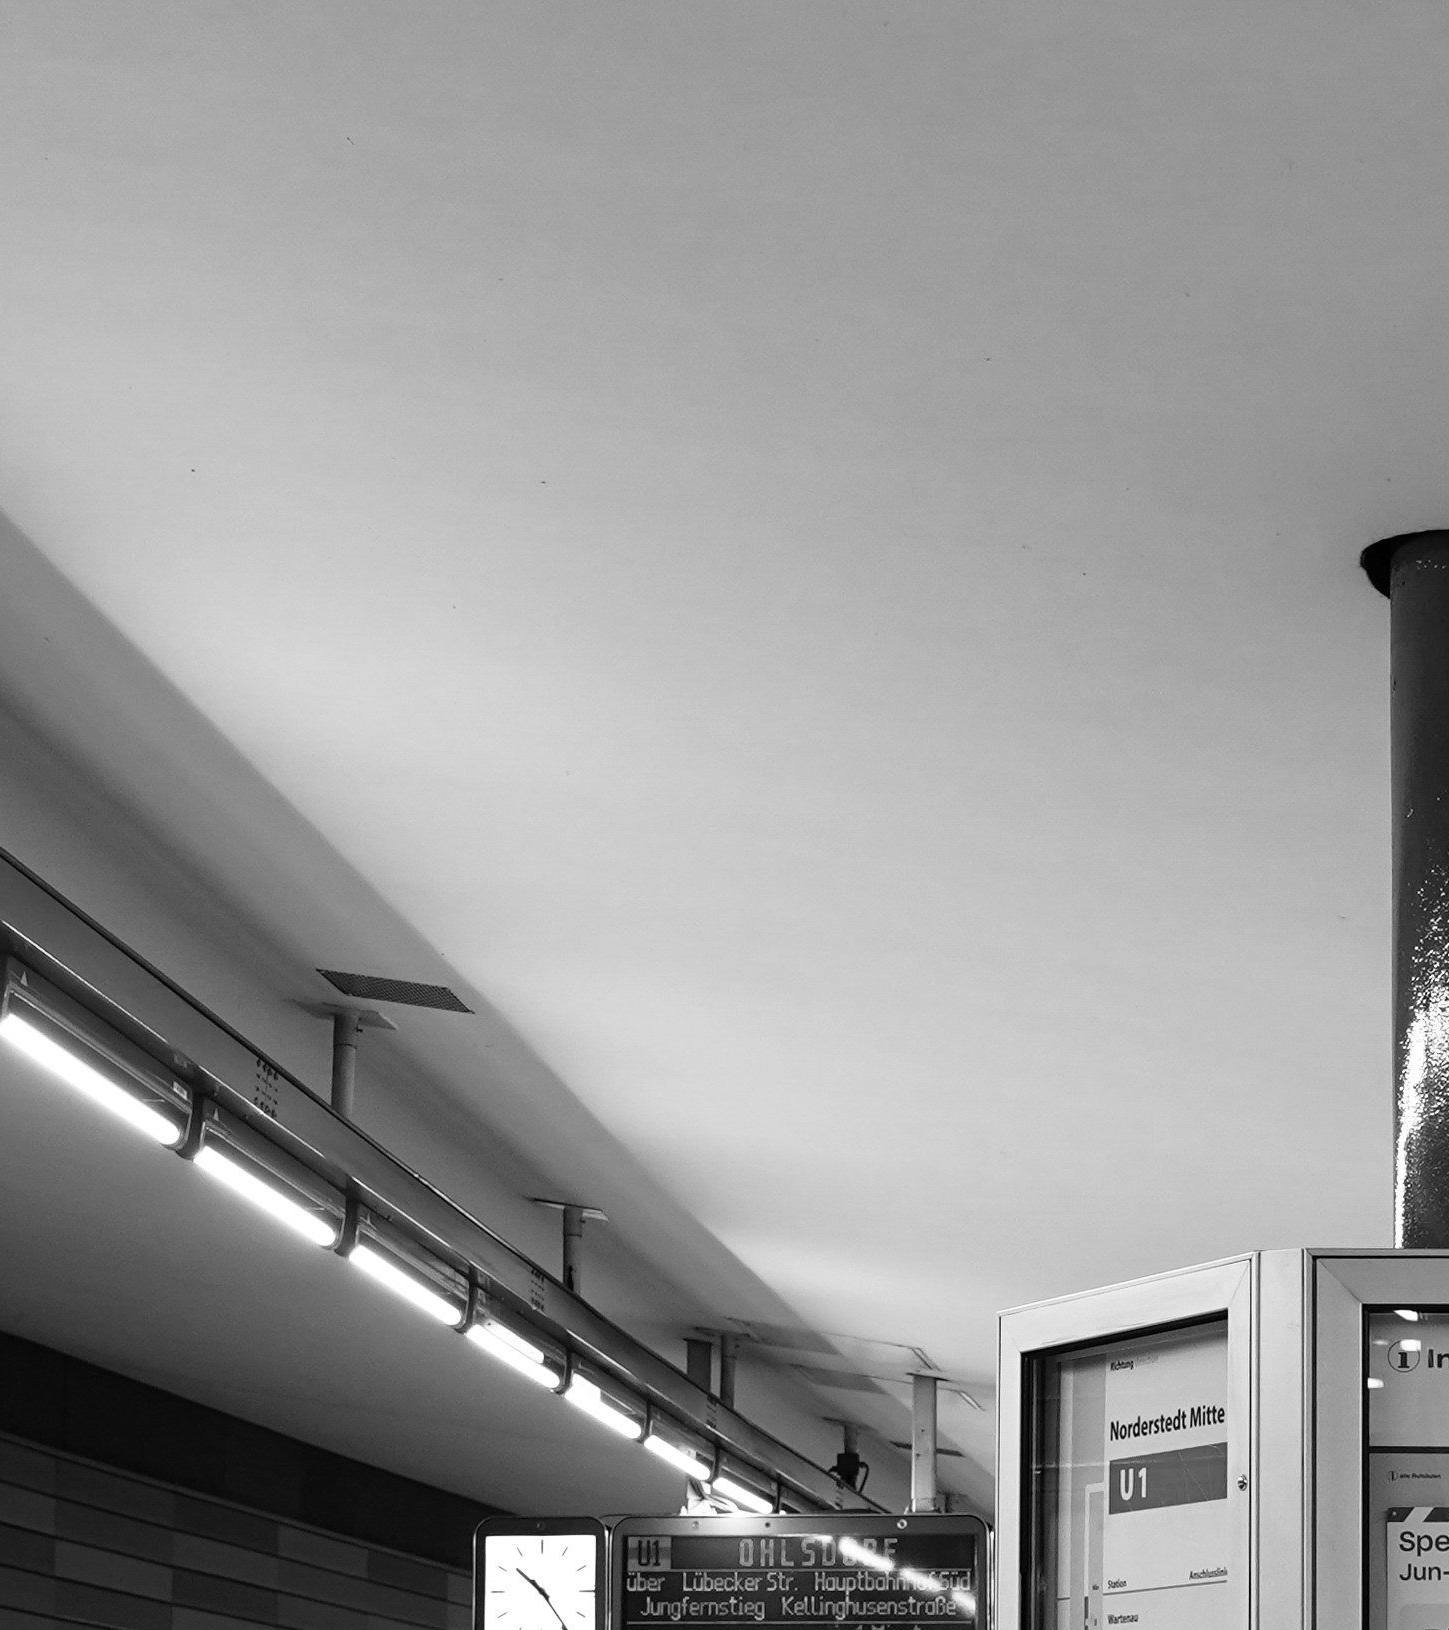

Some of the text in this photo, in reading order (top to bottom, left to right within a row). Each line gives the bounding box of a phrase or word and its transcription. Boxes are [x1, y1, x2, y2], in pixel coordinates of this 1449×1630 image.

[1109, 1358, 1134, 1372] Richtung
[1109, 1405, 1225, 1442] Norderstedt Mitte
[1119, 1467, 1147, 1501] U1
[637, 1539, 661, 1566] U1
[626, 1572, 665, 1592] über
[683, 1572, 763, 1592] Lübecker
[767, 1572, 799, 1592] Str.
[939, 1571, 971, 1592] Süd
[1107, 1579, 1127, 1590] Station
[639, 1596, 957, 1621] Jungfernstieg Kellinghusenstraße
[1107, 1613, 1139, 1625] Wartenau
